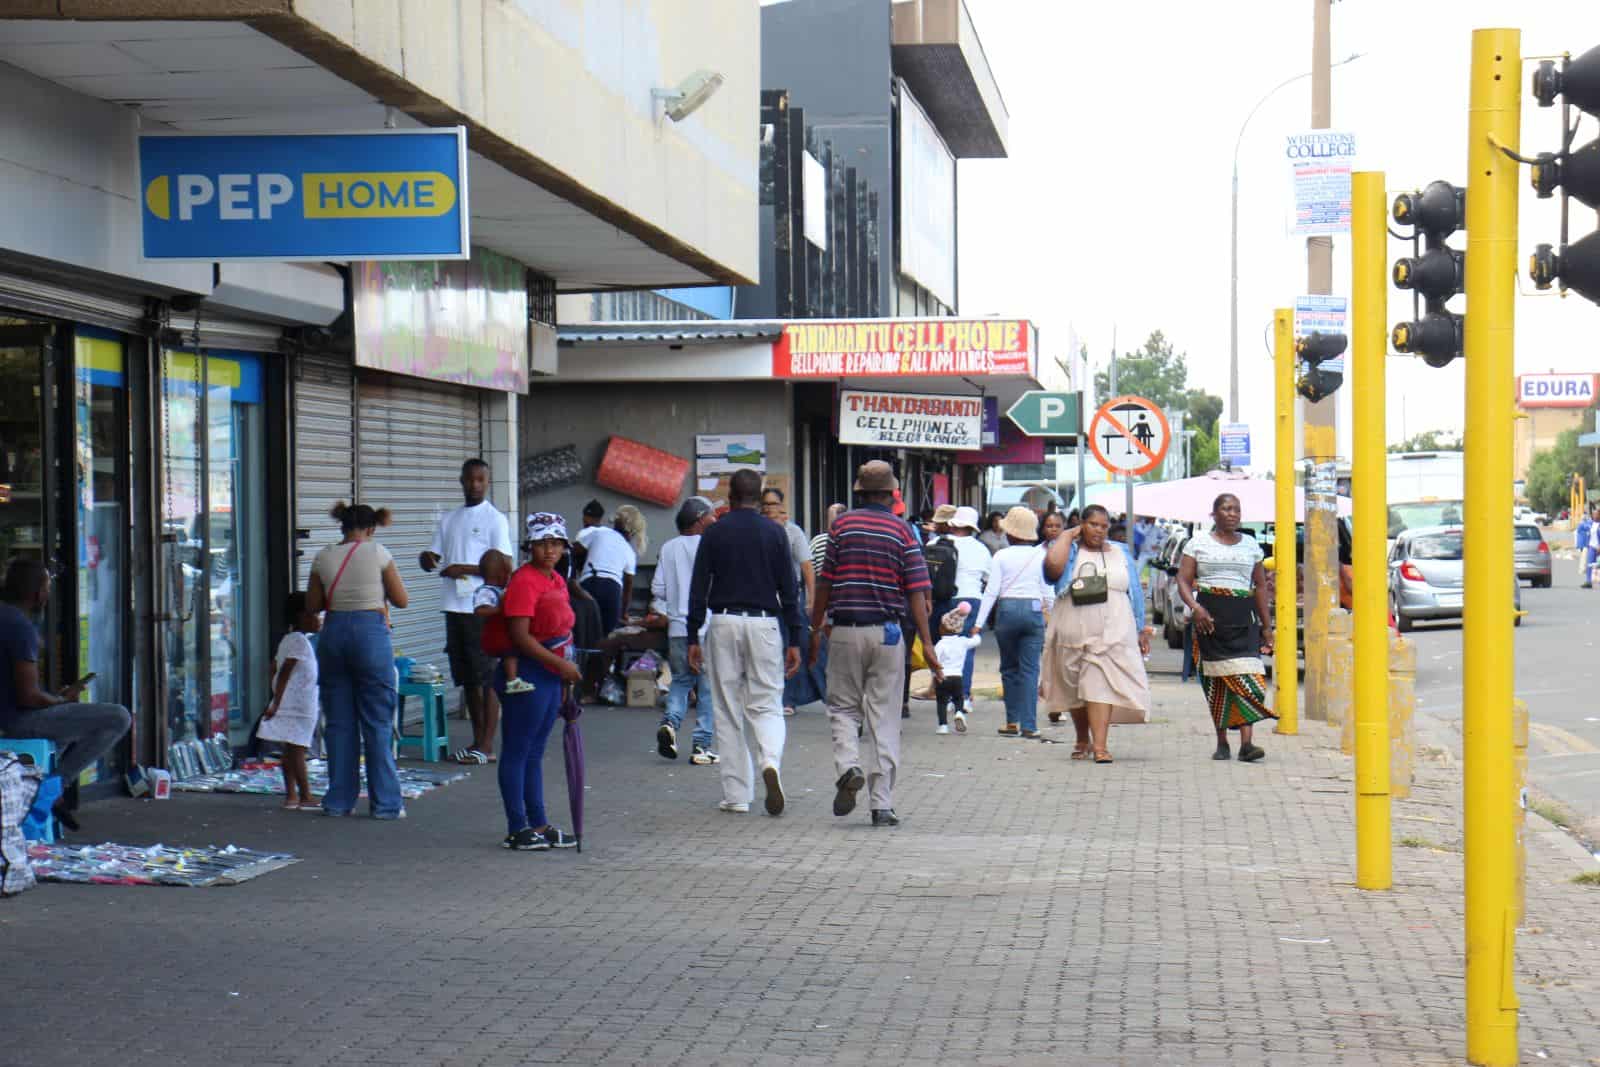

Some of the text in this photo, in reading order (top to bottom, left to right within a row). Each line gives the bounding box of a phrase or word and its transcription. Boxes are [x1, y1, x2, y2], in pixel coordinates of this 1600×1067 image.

[1286, 143, 1356, 158] COLLEGE
[177, 174, 435, 220] PEP HOME
[900, 351, 911, 373] &
[911, 351, 929, 371] ALL
[930, 350, 995, 371] APPLIANCES
[1524, 381, 1591, 396] EDURA
[1040, 398, 1065, 429] P
